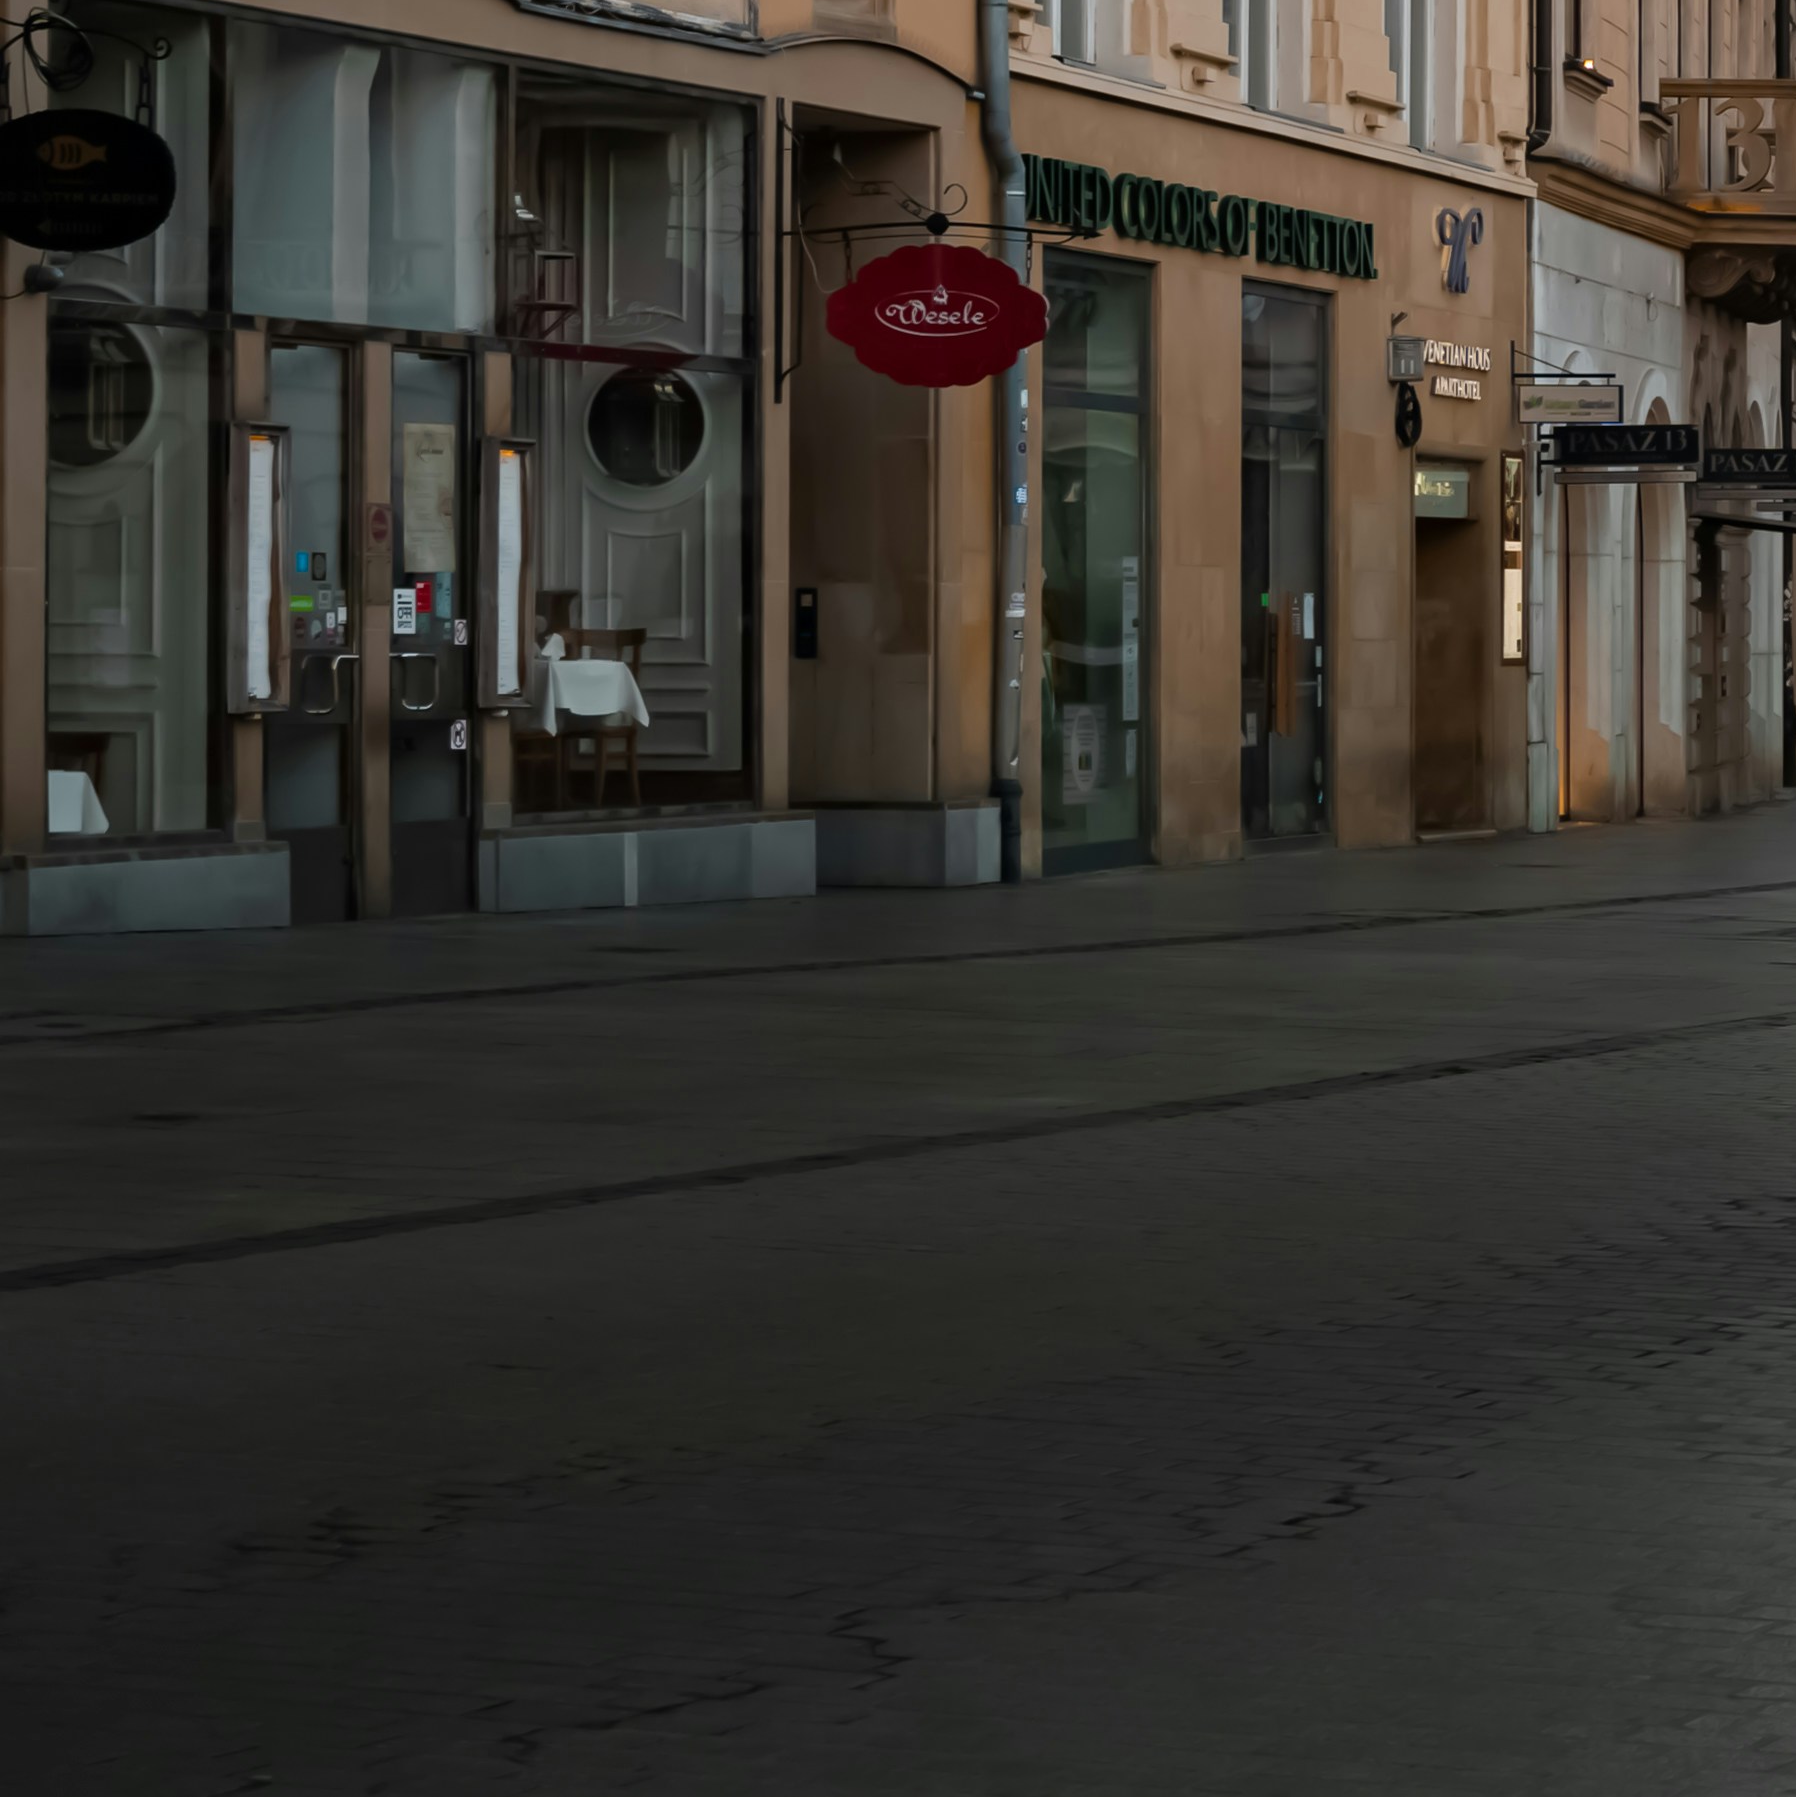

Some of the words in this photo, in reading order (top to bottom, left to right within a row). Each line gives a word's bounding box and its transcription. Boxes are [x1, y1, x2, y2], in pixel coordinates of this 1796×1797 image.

[1664, 96, 1772, 192] 13
[1111, 173, 1221, 252] COLORS
[1218, 195, 1259, 256] OF
[885, 299, 988, 325] Wesele
[1424, 339, 1466, 367] VENETIAN
[1433, 376, 1482, 401] APARTHOTEL
[1665, 429, 1688, 452] 13
[1709, 454, 1788, 473] PASAZ
